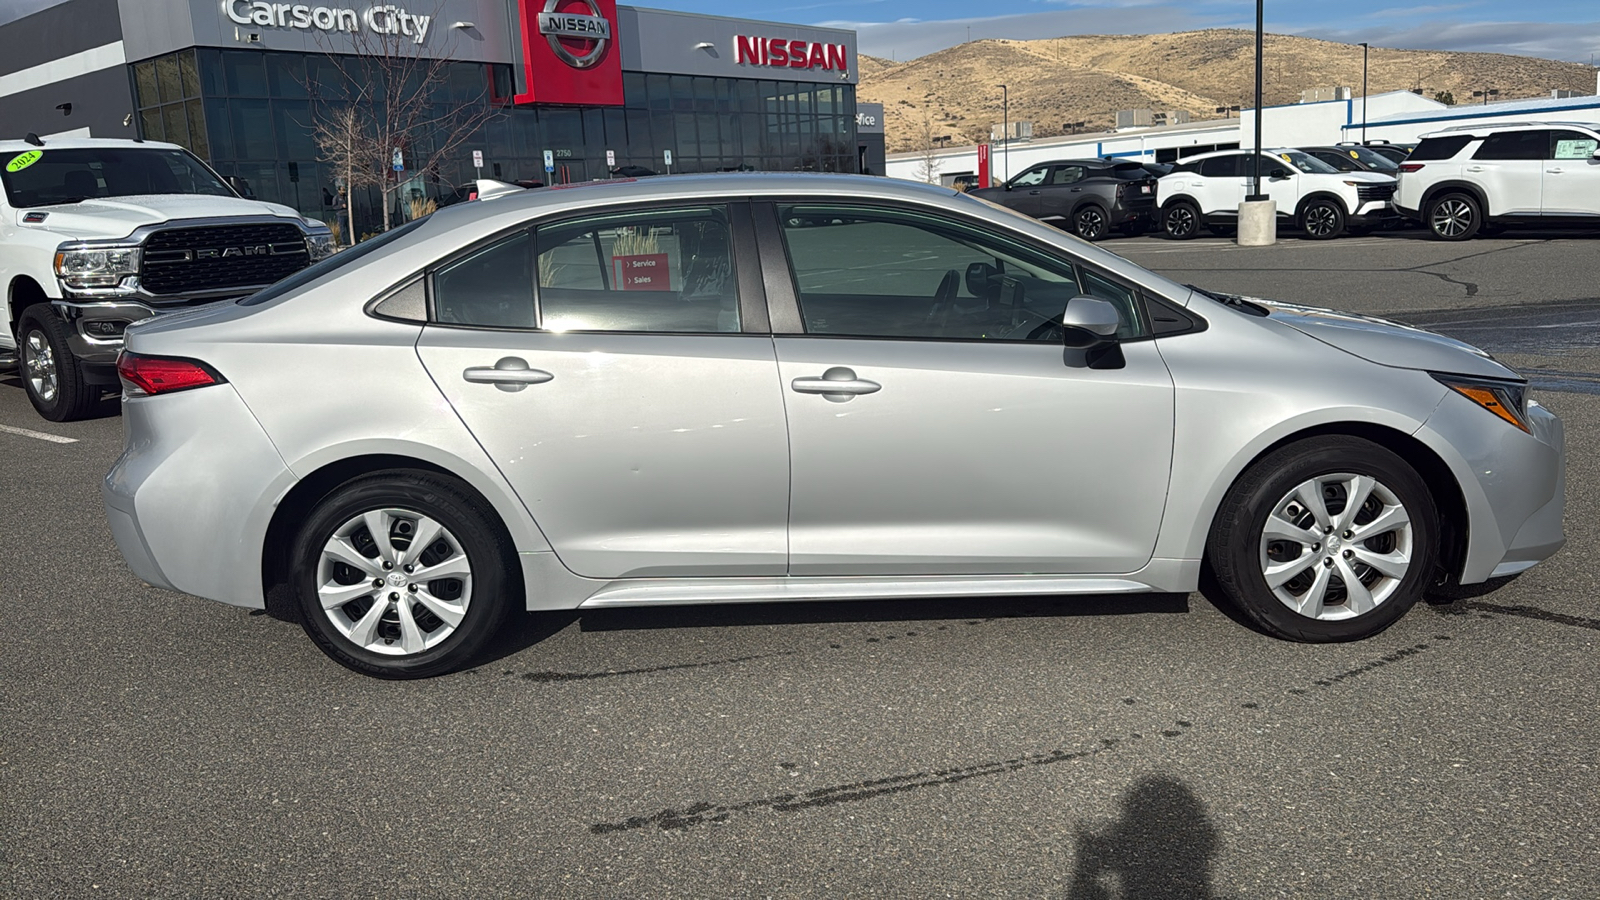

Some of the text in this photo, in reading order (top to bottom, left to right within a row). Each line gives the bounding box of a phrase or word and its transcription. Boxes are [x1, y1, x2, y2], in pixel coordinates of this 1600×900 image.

[224, 0, 431, 44] Carson City
[548, 16, 606, 35] NISSAN
[735, 34, 847, 71] NISSAN
[11, 152, 36, 170] 2024
[556, 149, 572, 157] 2750
[197, 245, 267, 260] RAM
[632, 259, 656, 268] Service
[633, 275, 652, 284] Sales
